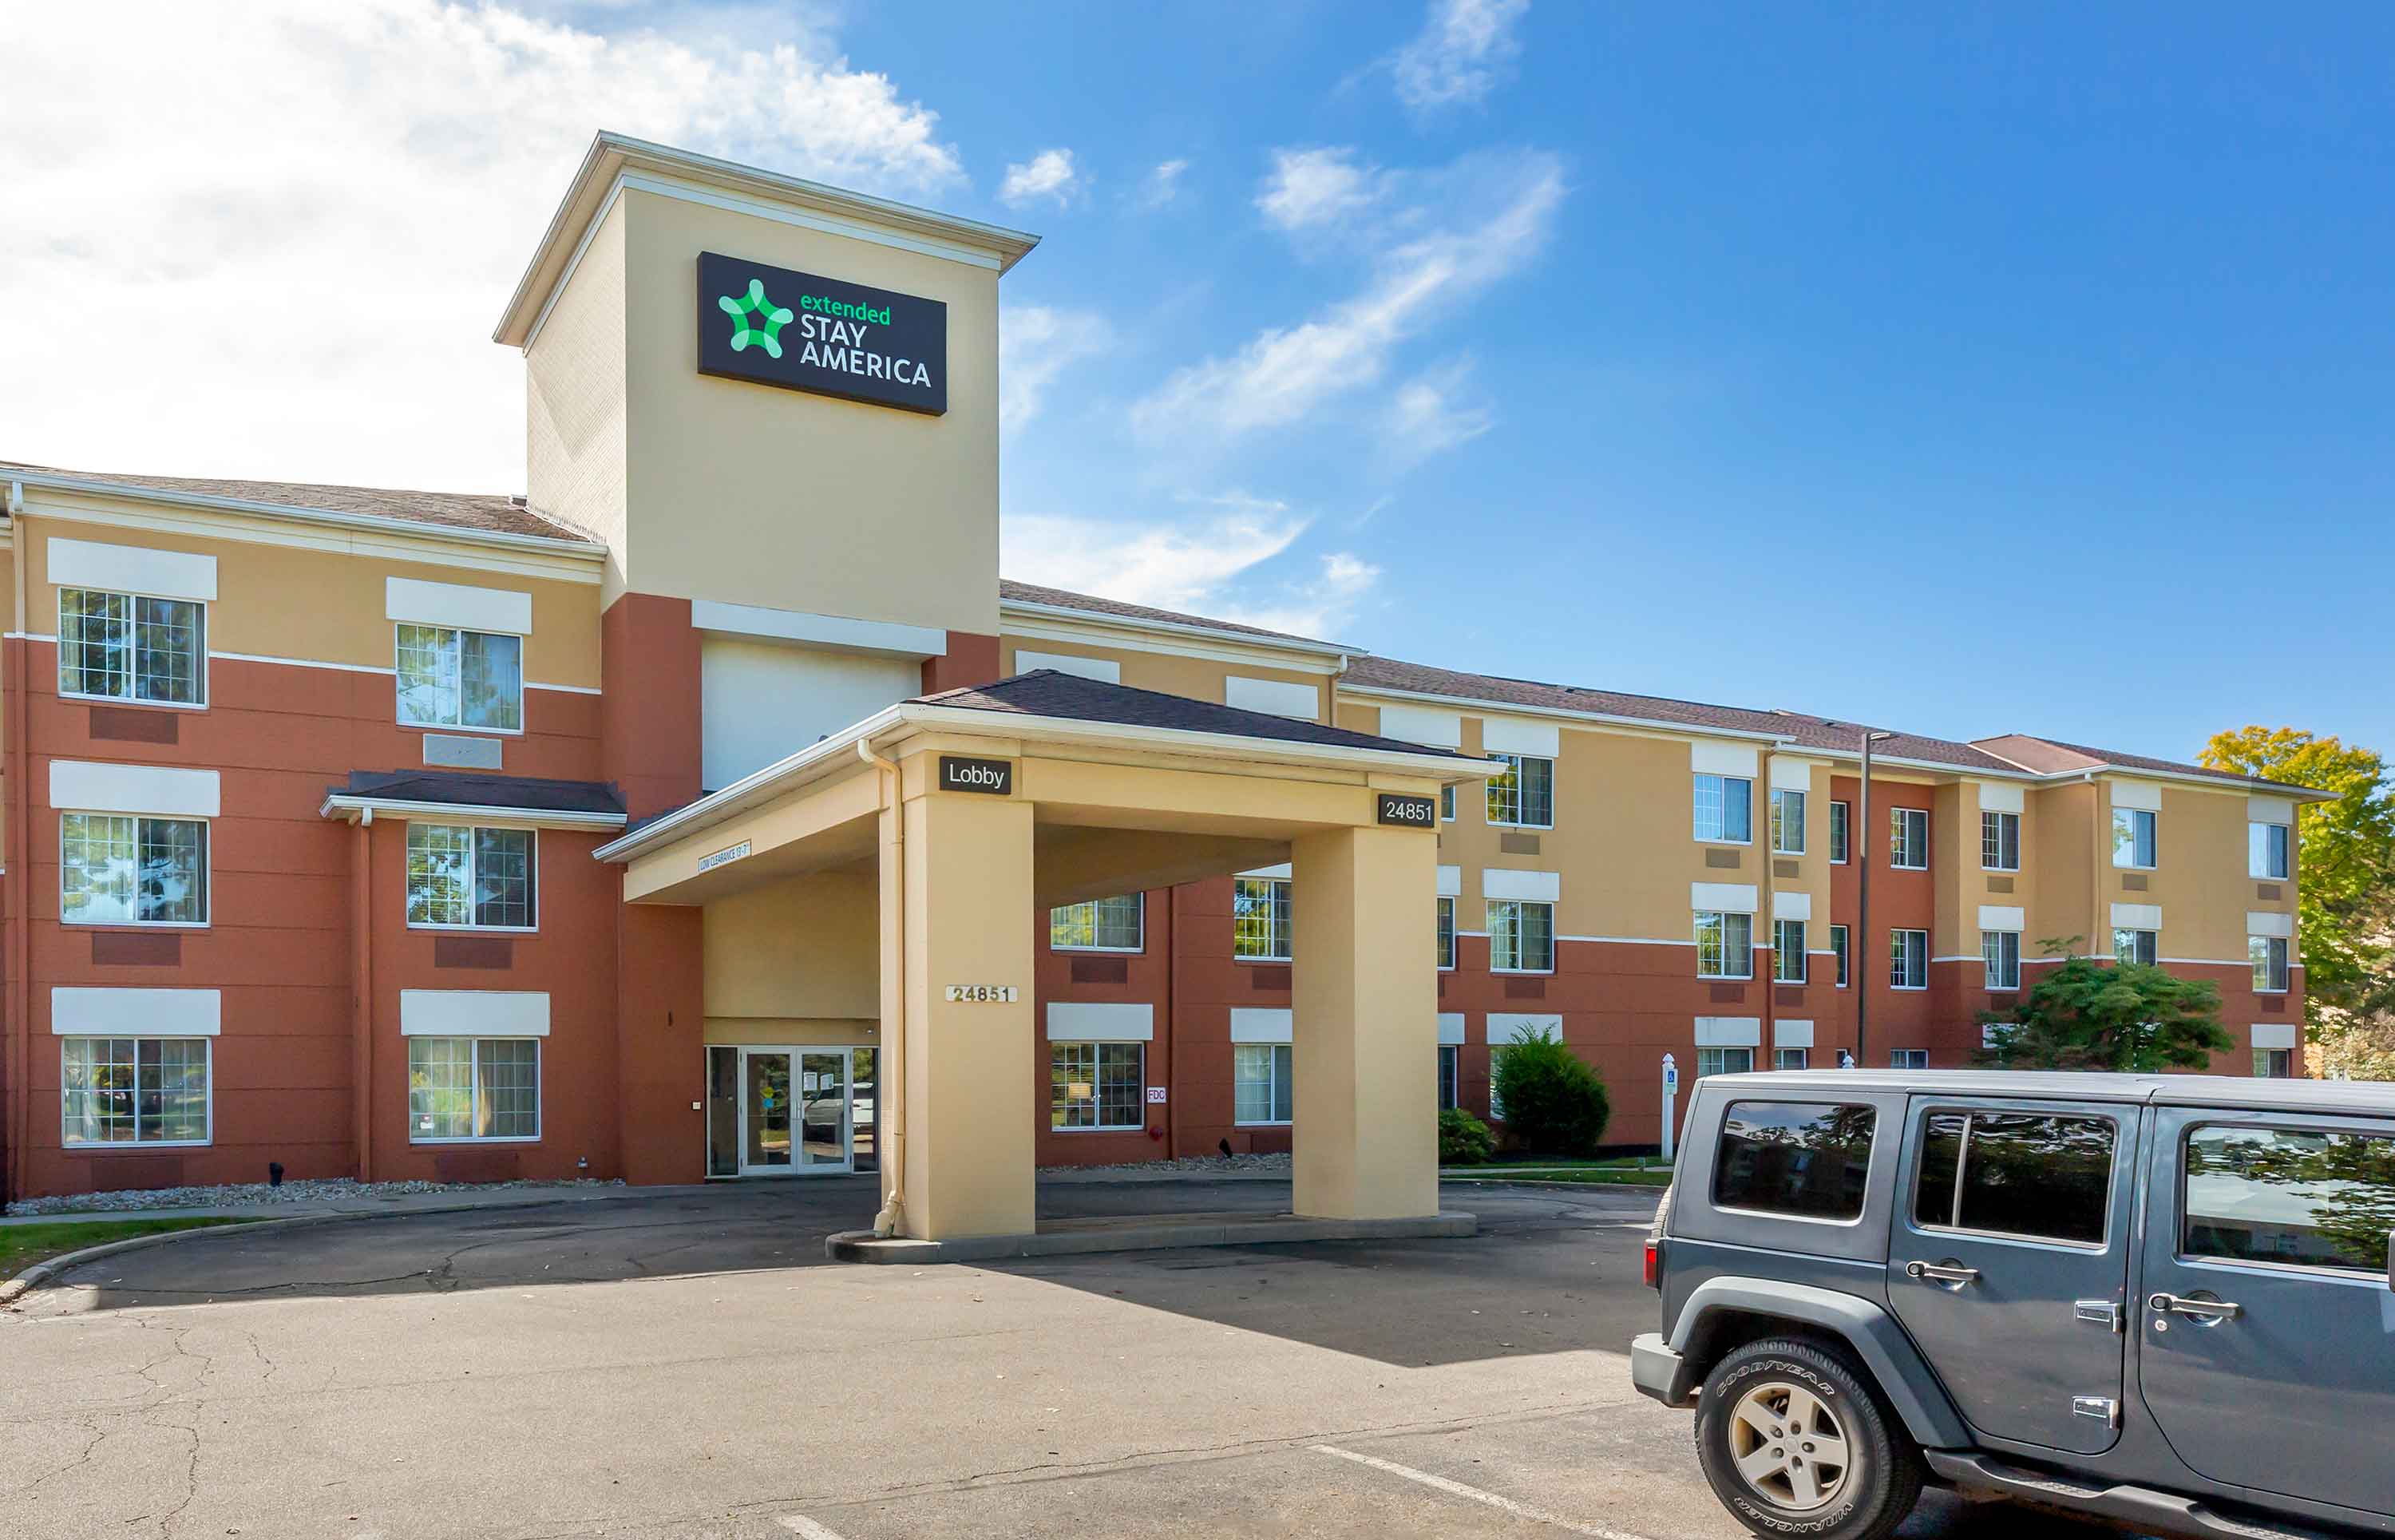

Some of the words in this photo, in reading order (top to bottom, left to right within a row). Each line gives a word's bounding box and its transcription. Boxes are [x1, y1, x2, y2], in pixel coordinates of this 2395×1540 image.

[800, 295, 891, 326] extended
[800, 314, 868, 348] STAY
[800, 341, 932, 388] AMERICA
[949, 763, 1005, 789] Lobby
[1386, 802, 1431, 821] 24851
[710, 848, 735, 866] CLEARANCE
[952, 986, 1009, 1002] 24851
[1148, 1090, 1165, 1099] FDC
[1716, 1360, 1835, 1397] GOODYEAR
[1733, 1496, 1854, 1533] WRANGLER
